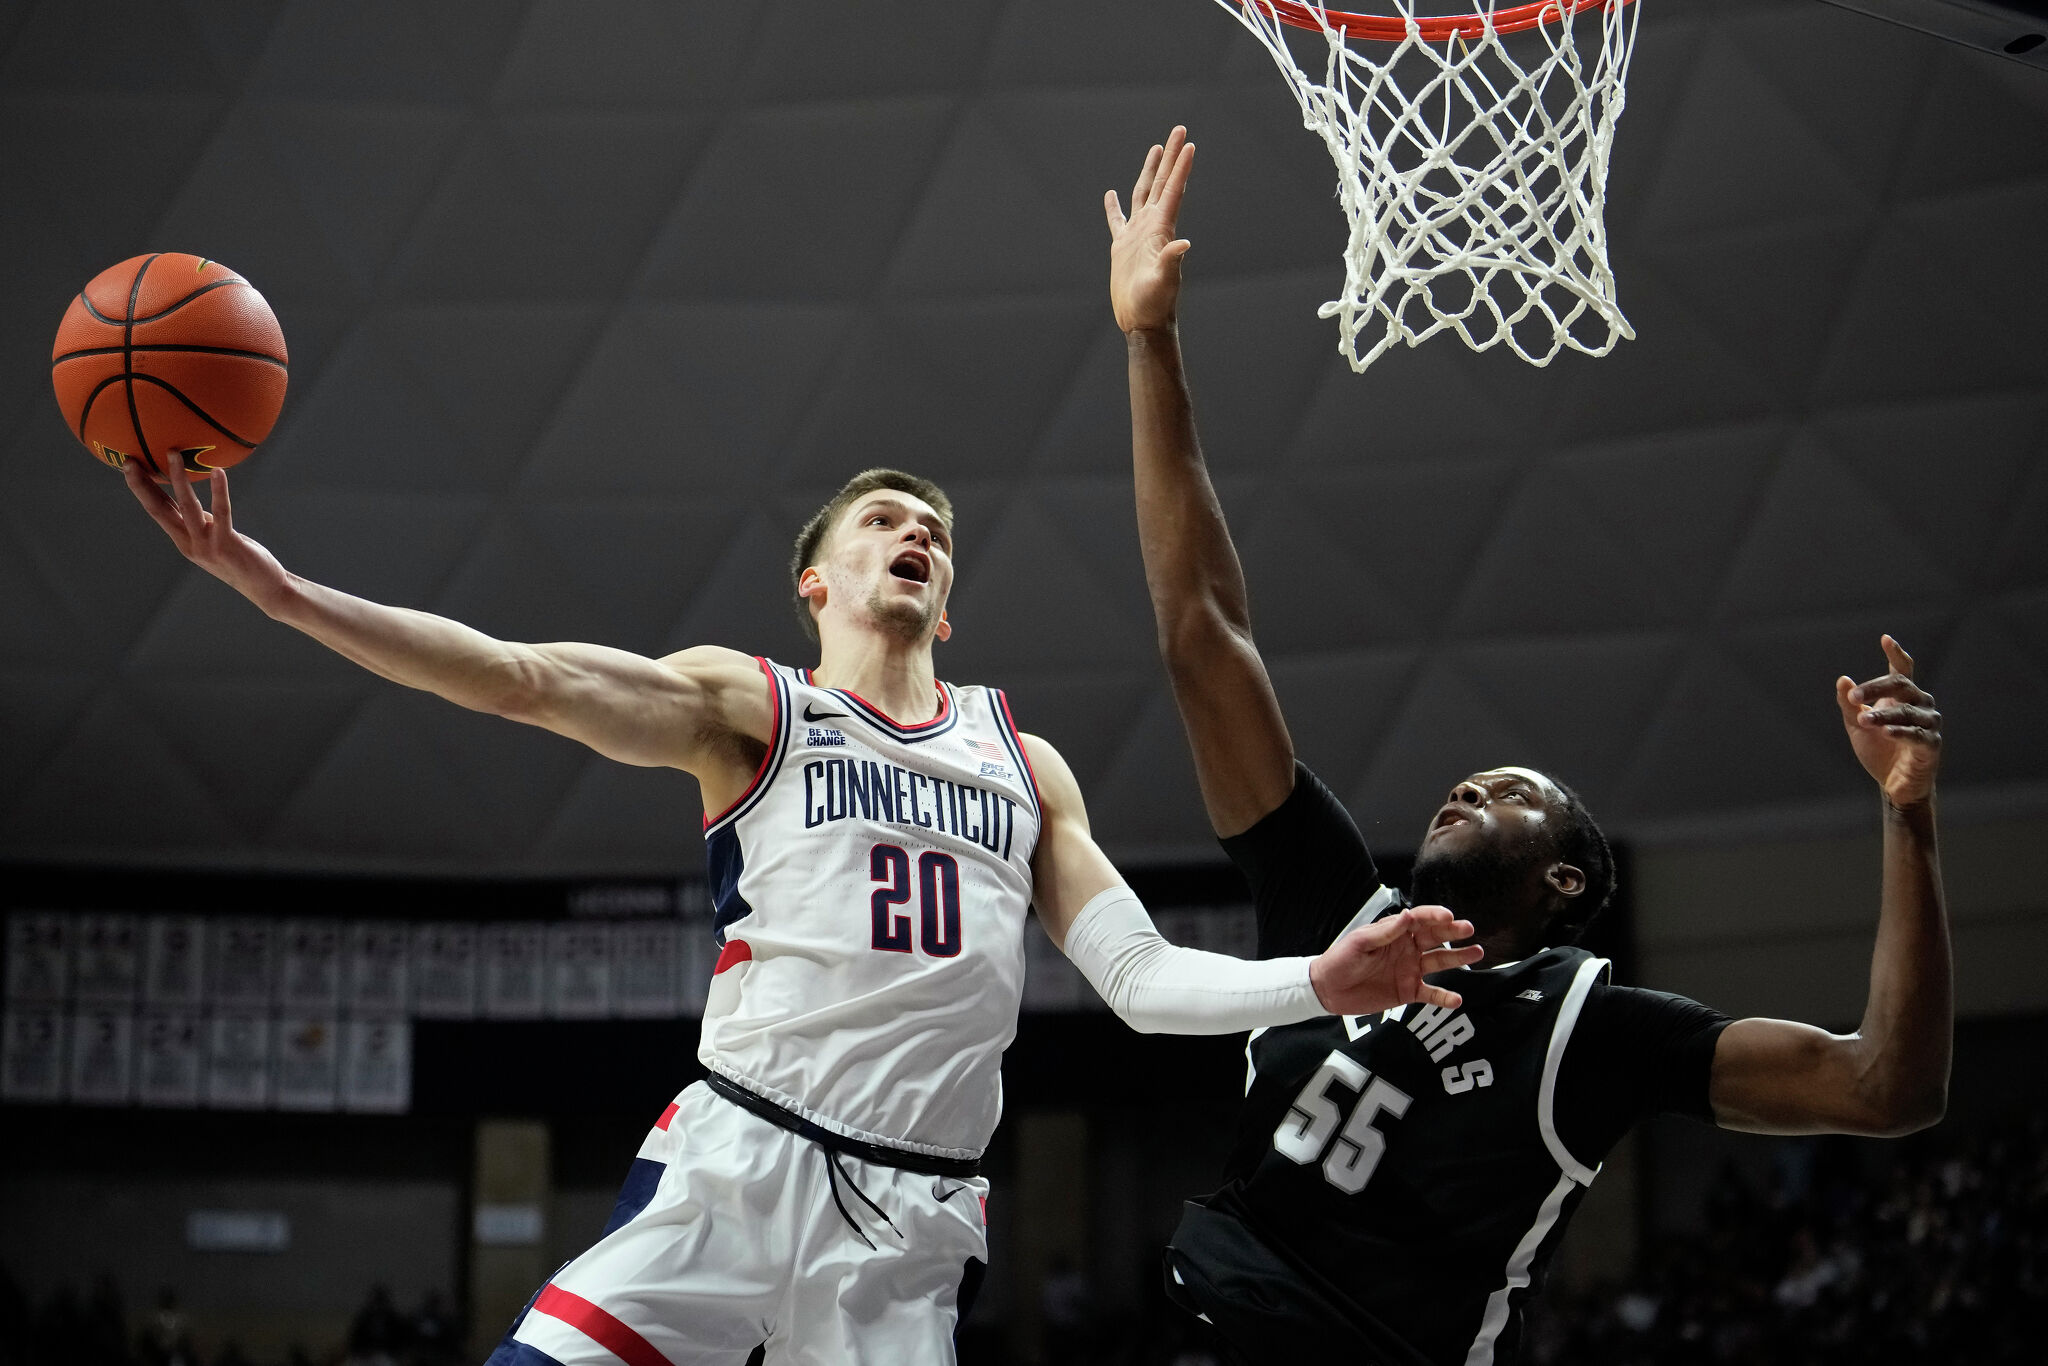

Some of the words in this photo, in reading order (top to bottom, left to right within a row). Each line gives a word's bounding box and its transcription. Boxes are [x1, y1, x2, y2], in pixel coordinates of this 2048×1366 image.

[808, 728, 822, 736] BE
[807, 736, 846, 746] CHANGE
[981, 761, 1005, 771] BIG
[980, 768, 1013, 779] EAST
[804, 759, 1016, 861] CONNECTICUT
[870, 843, 962, 957] 20
[1273, 1048, 1414, 1195] 55
